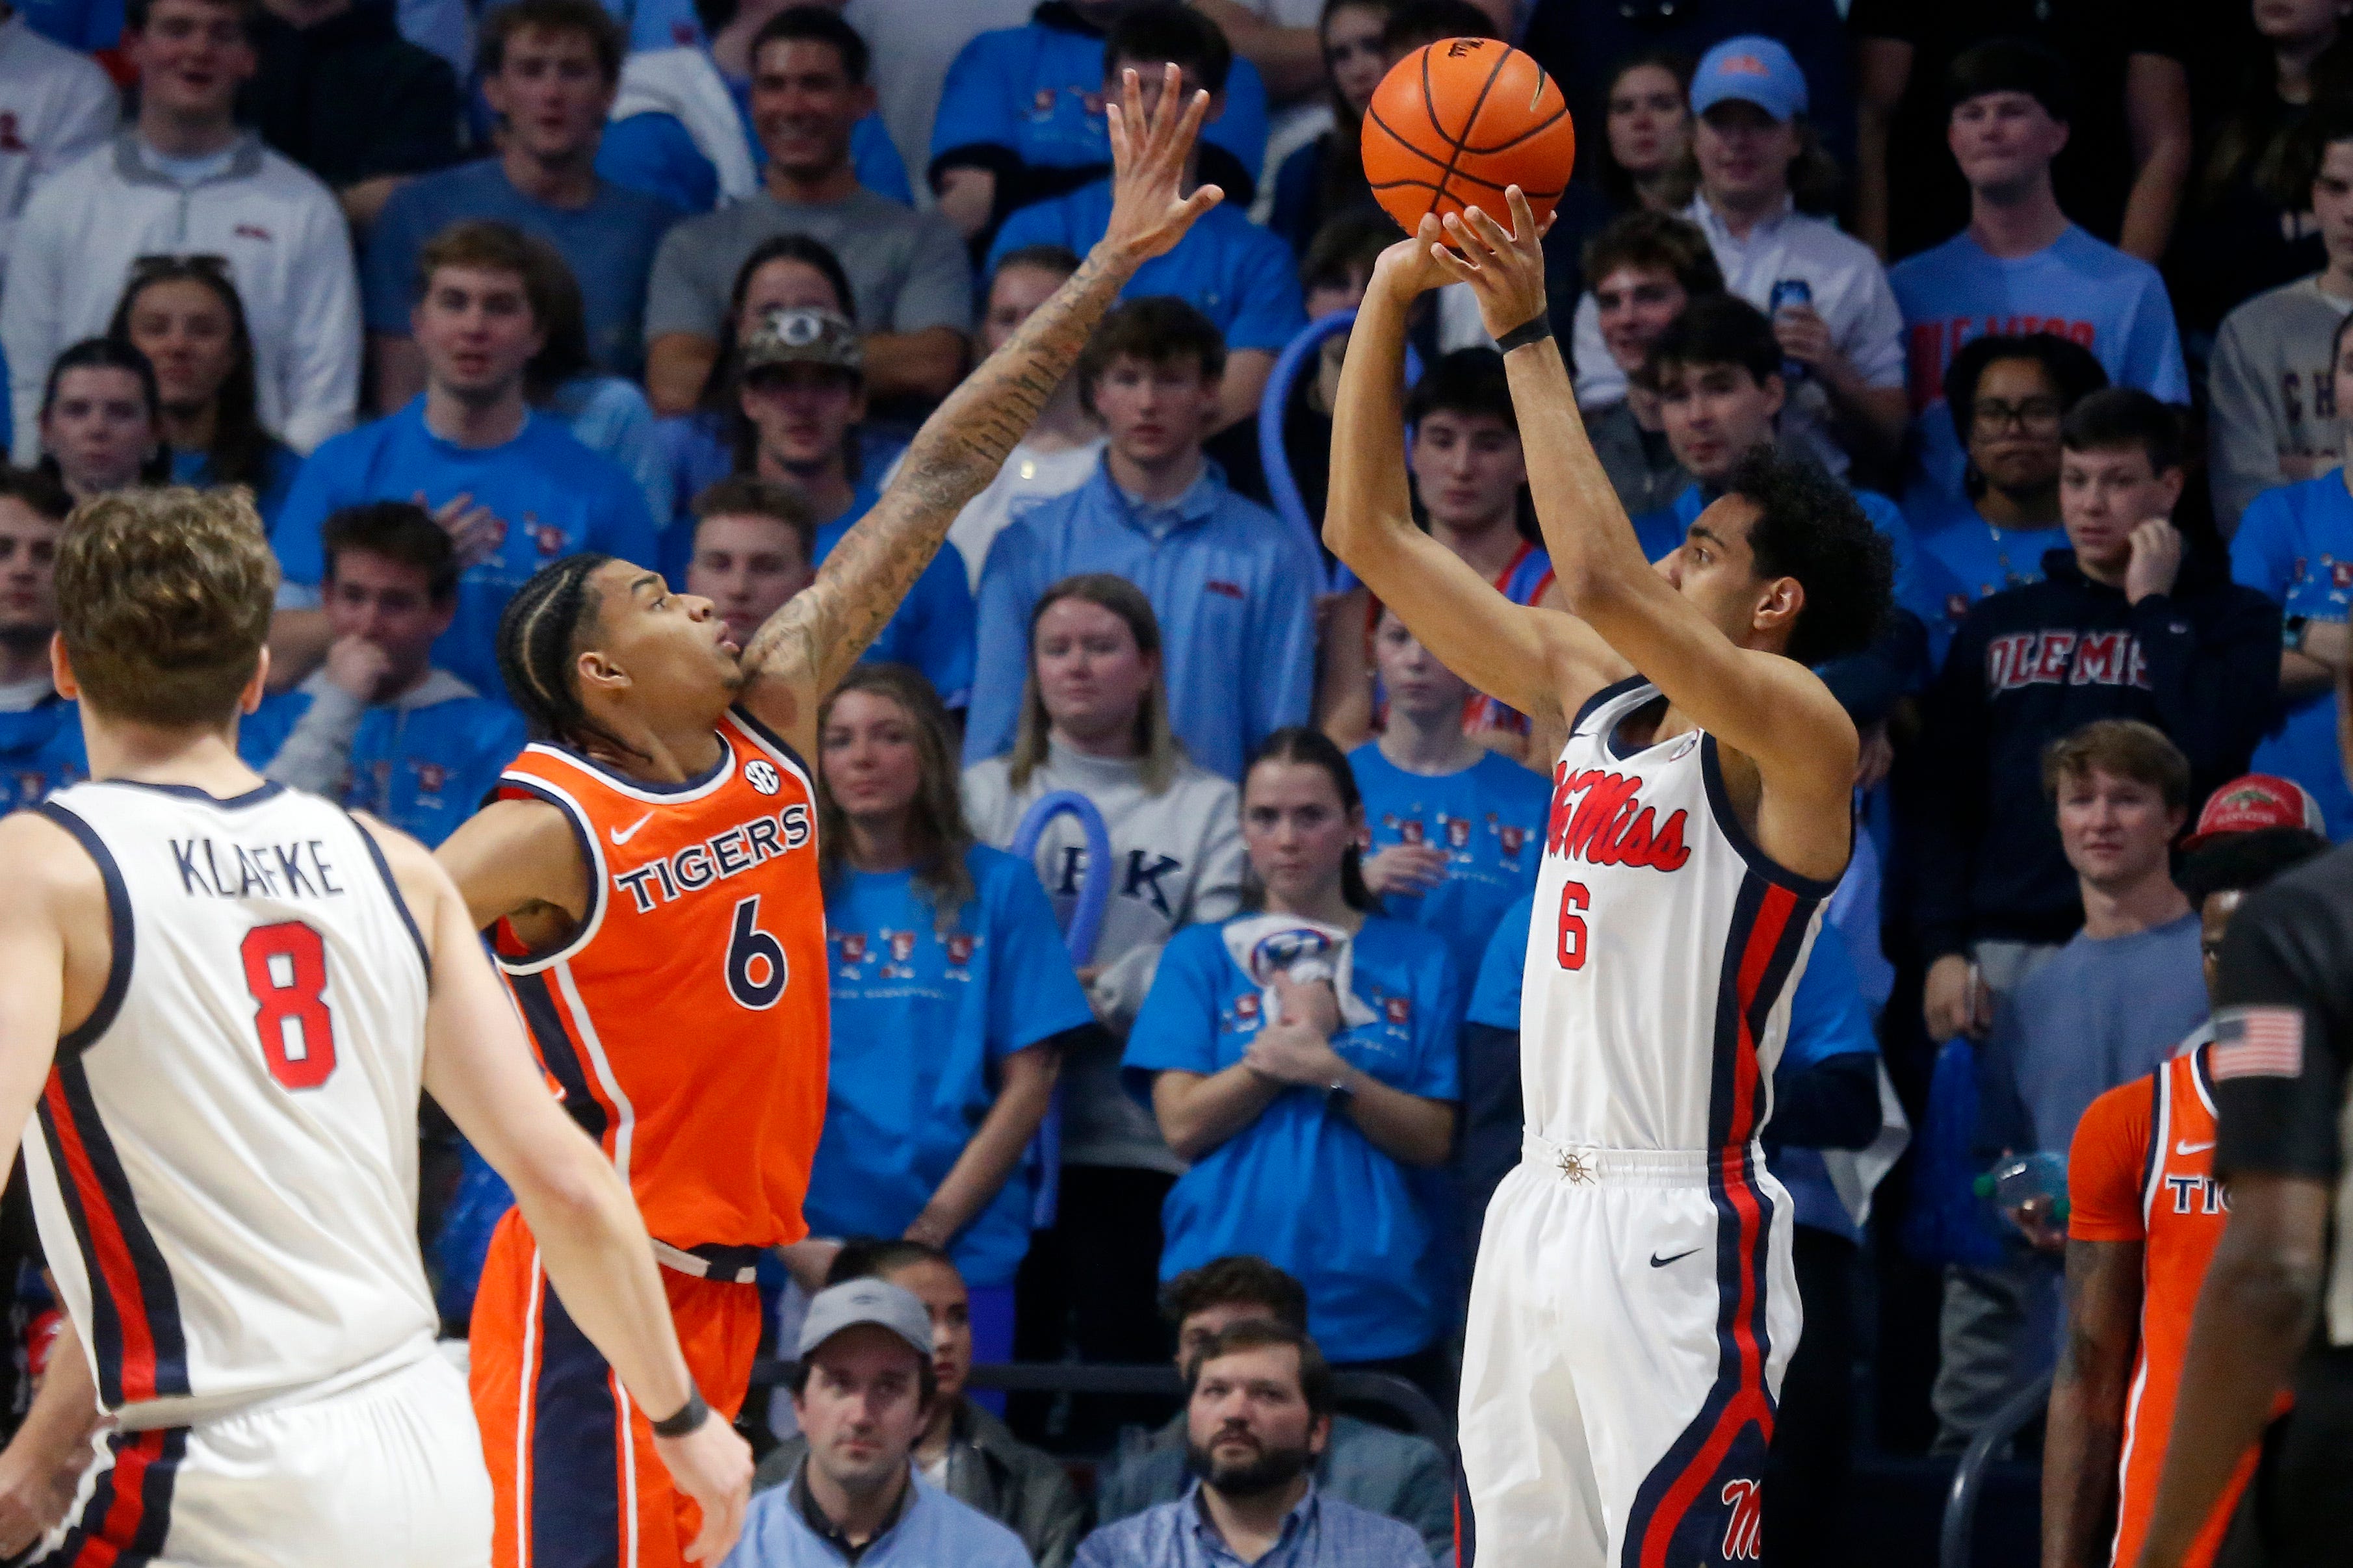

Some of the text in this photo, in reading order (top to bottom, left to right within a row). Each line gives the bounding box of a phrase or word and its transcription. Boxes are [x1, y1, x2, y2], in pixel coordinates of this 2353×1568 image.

[743, 759, 781, 796] SEC
[1565, 769, 1692, 872] Miss
[168, 838, 344, 898] KLAFKE
[612, 803, 812, 915] TIGERS
[724, 893, 789, 1011] 6
[1557, 880, 1591, 971] 6
[240, 919, 338, 1090] 8
